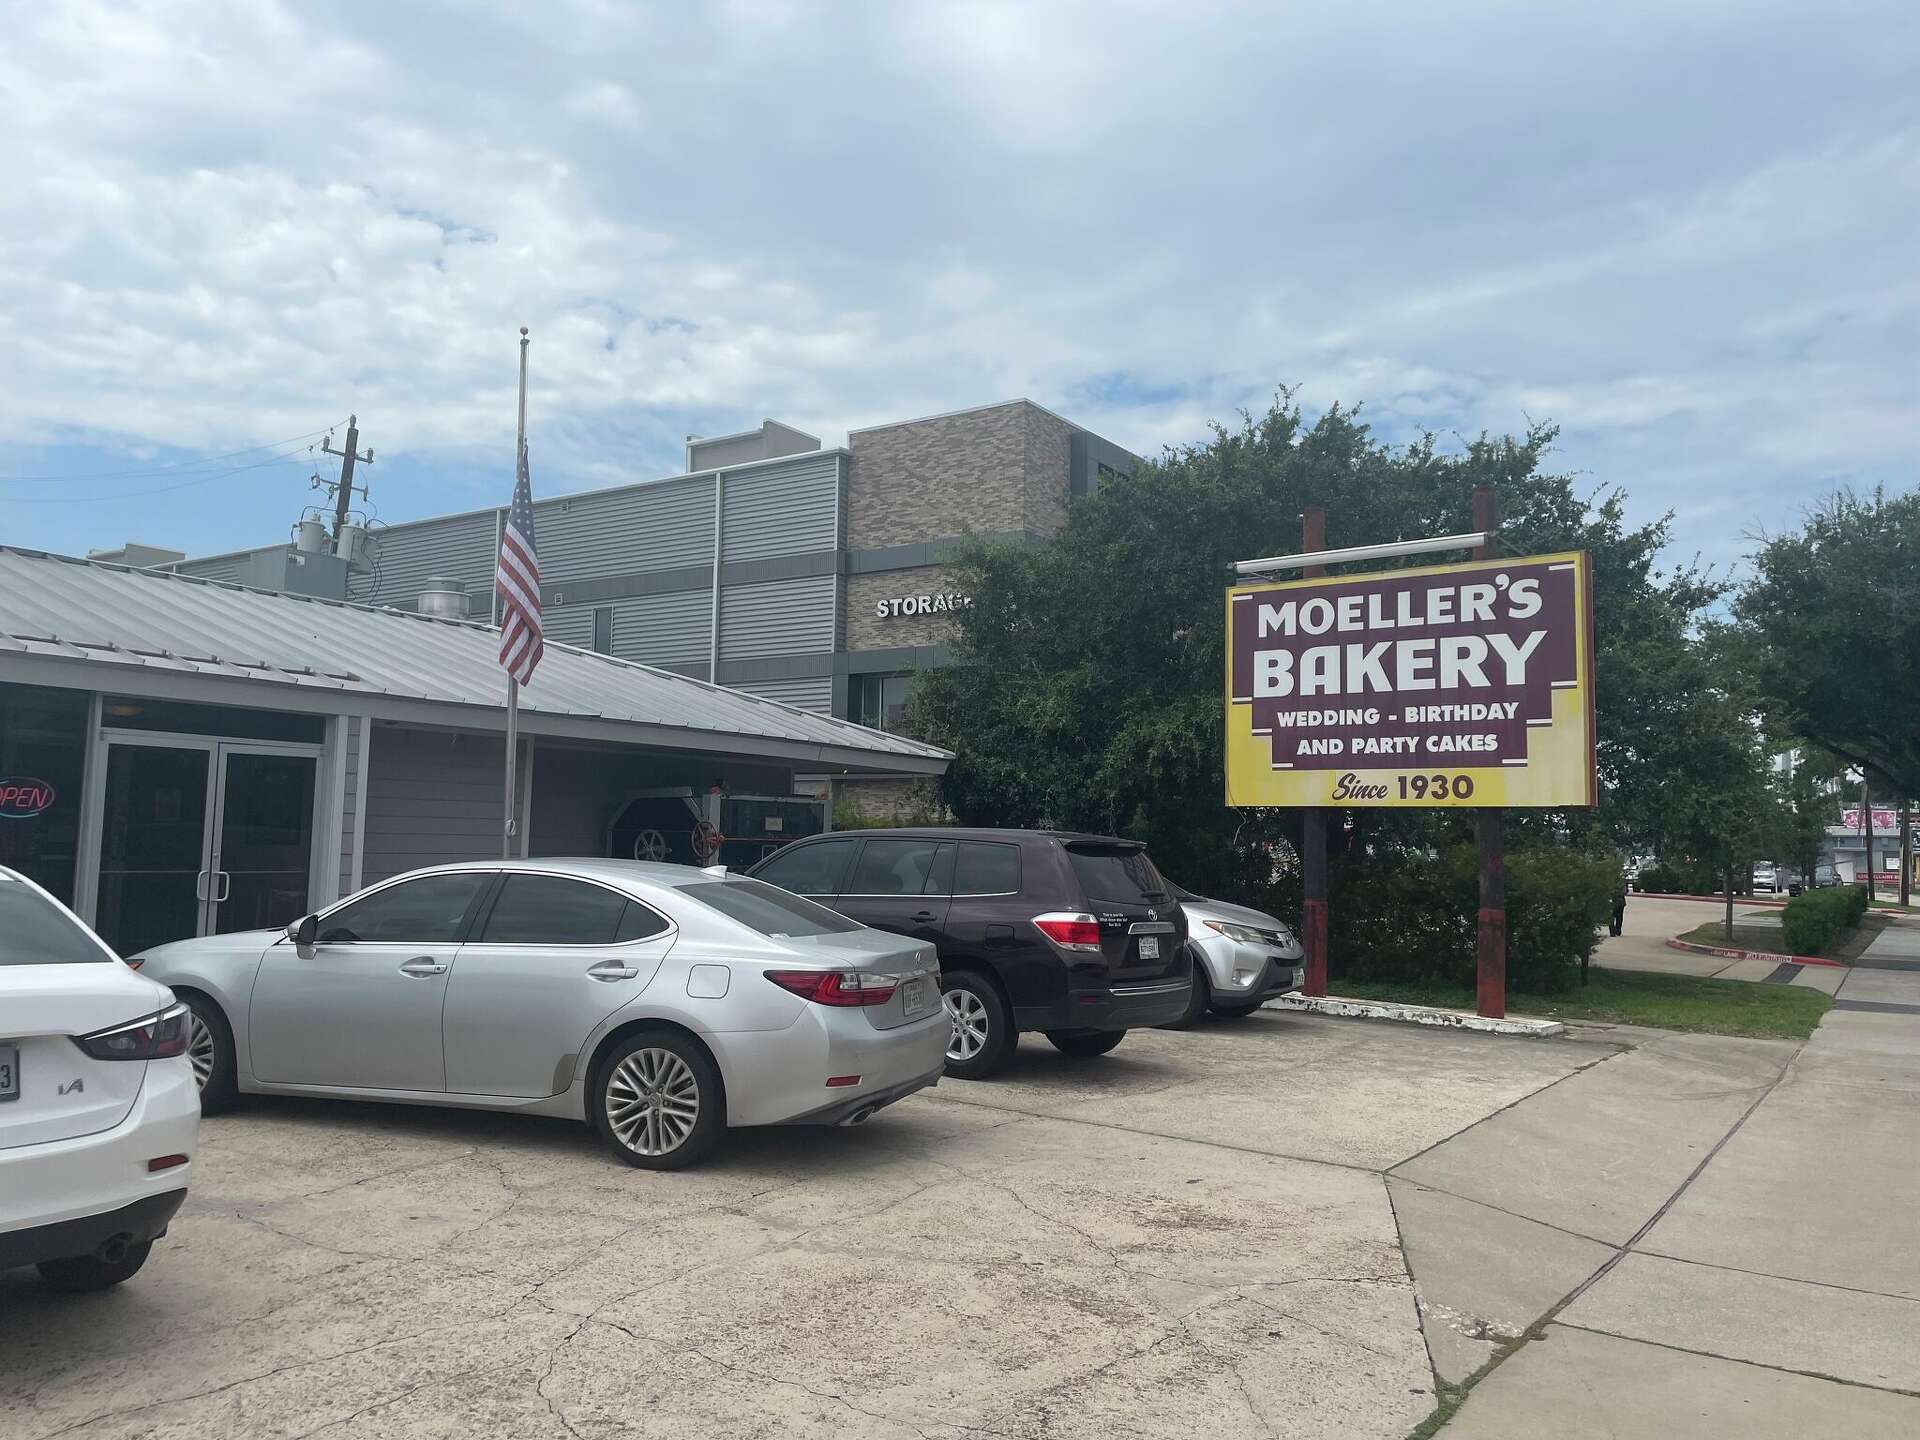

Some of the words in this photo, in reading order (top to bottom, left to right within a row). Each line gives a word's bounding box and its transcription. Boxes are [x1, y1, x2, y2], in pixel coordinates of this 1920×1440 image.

[1258, 573, 1543, 638] MOELLER'S
[1253, 630, 1548, 698] BAKERY
[1277, 707, 1380, 728] WEDDING
[1404, 702, 1520, 723] BIRTHDAY
[1296, 738, 1344, 755] AND
[1351, 736, 1420, 754] PARTY
[1425, 734, 1499, 753] CAKES
[0, 786, 49, 809] PEN
[1331, 772, 1389, 801] Since
[1397, 774, 1475, 800] 1930
